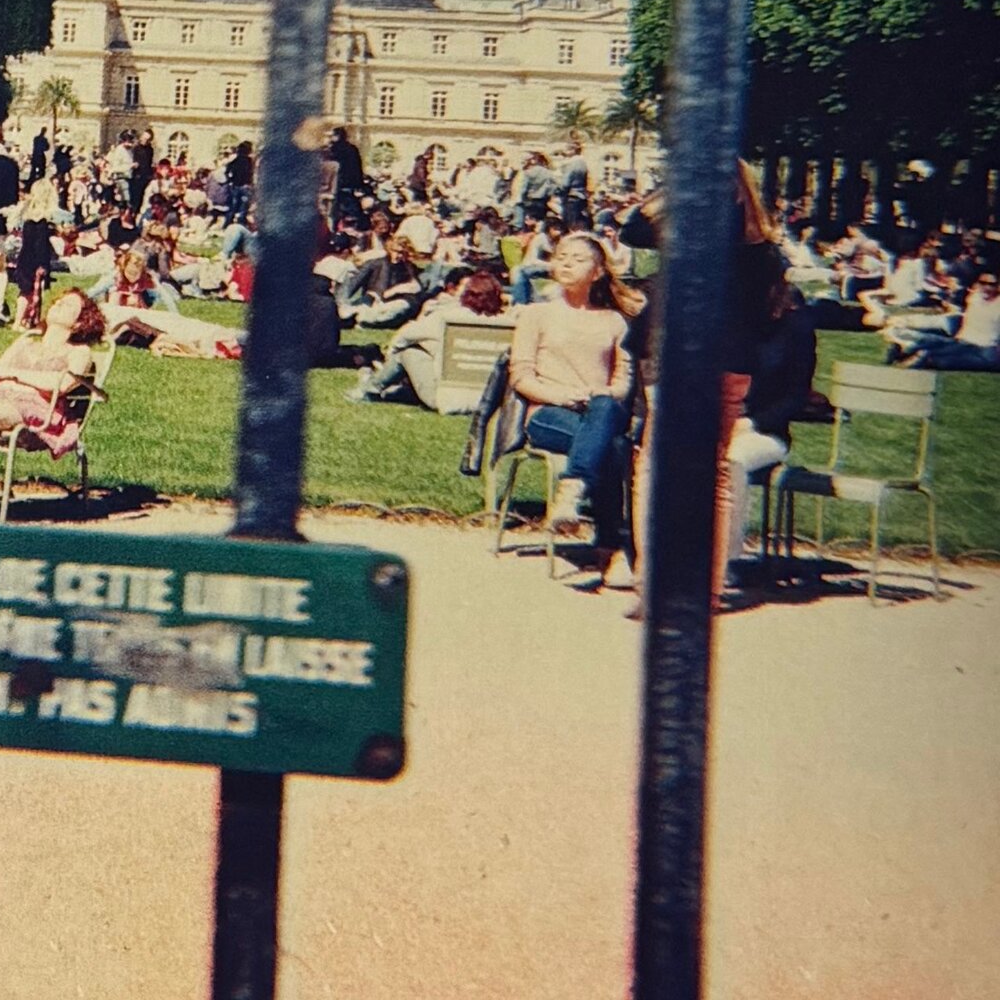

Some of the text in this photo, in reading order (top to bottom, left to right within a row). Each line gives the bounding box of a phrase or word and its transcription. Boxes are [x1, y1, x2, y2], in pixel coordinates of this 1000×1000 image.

[54, 562, 174, 613] CETTE
[182, 571, 313, 624] LIMITE
[243, 634, 376, 687] LAISSE
[122, 681, 260, 738] ADMIS
